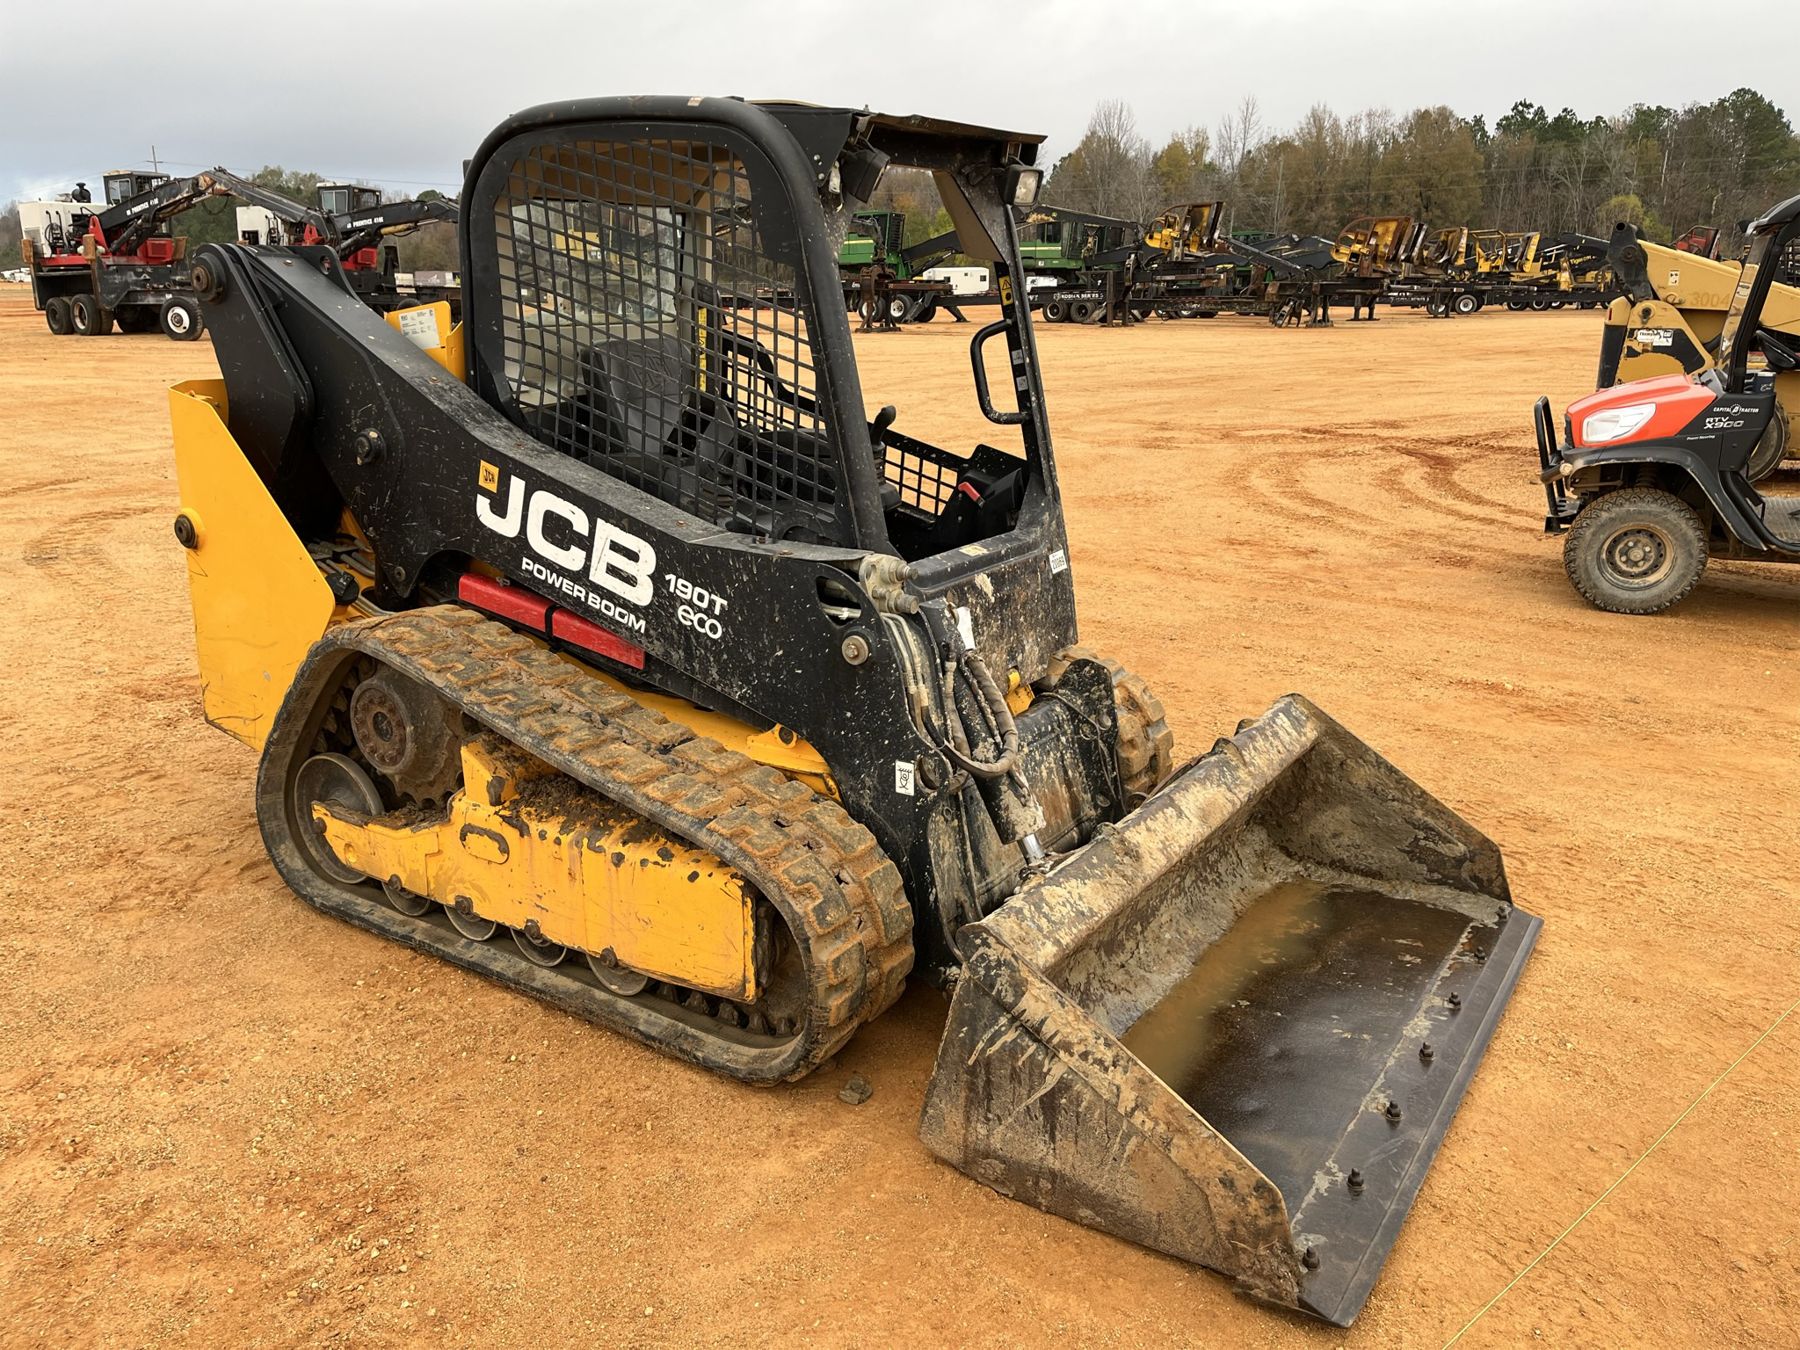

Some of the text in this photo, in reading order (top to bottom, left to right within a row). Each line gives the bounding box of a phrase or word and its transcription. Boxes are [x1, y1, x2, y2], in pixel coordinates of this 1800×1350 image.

[1704, 420, 1744, 429] X900
[476, 474, 657, 607] JCB
[522, 557, 646, 634] POWER BOOM
[664, 573, 728, 616] 190T
[677, 604, 722, 639] eco
